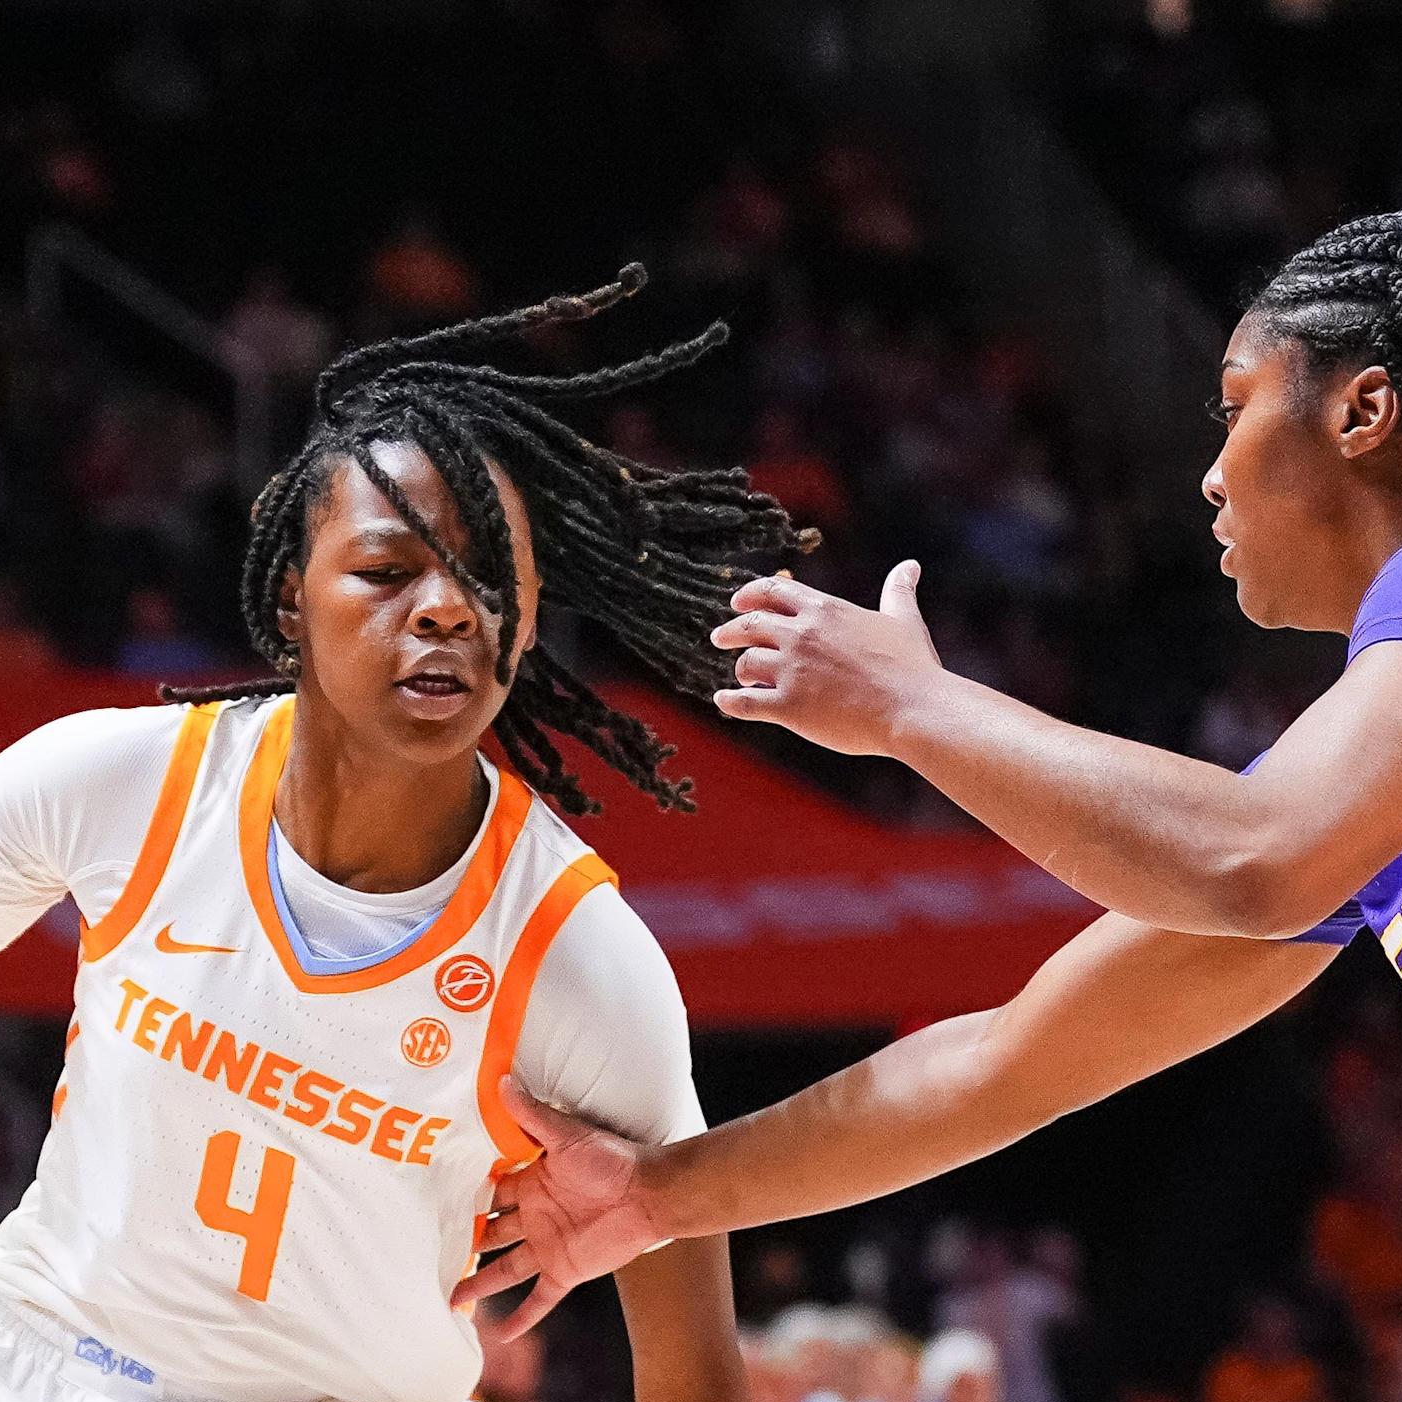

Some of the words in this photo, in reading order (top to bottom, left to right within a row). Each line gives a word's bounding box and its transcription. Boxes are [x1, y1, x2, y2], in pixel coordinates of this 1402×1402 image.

[116, 979, 452, 1167] TENNESSEE
[402, 1020, 450, 1065] SEC
[194, 1130, 296, 1303] 4
